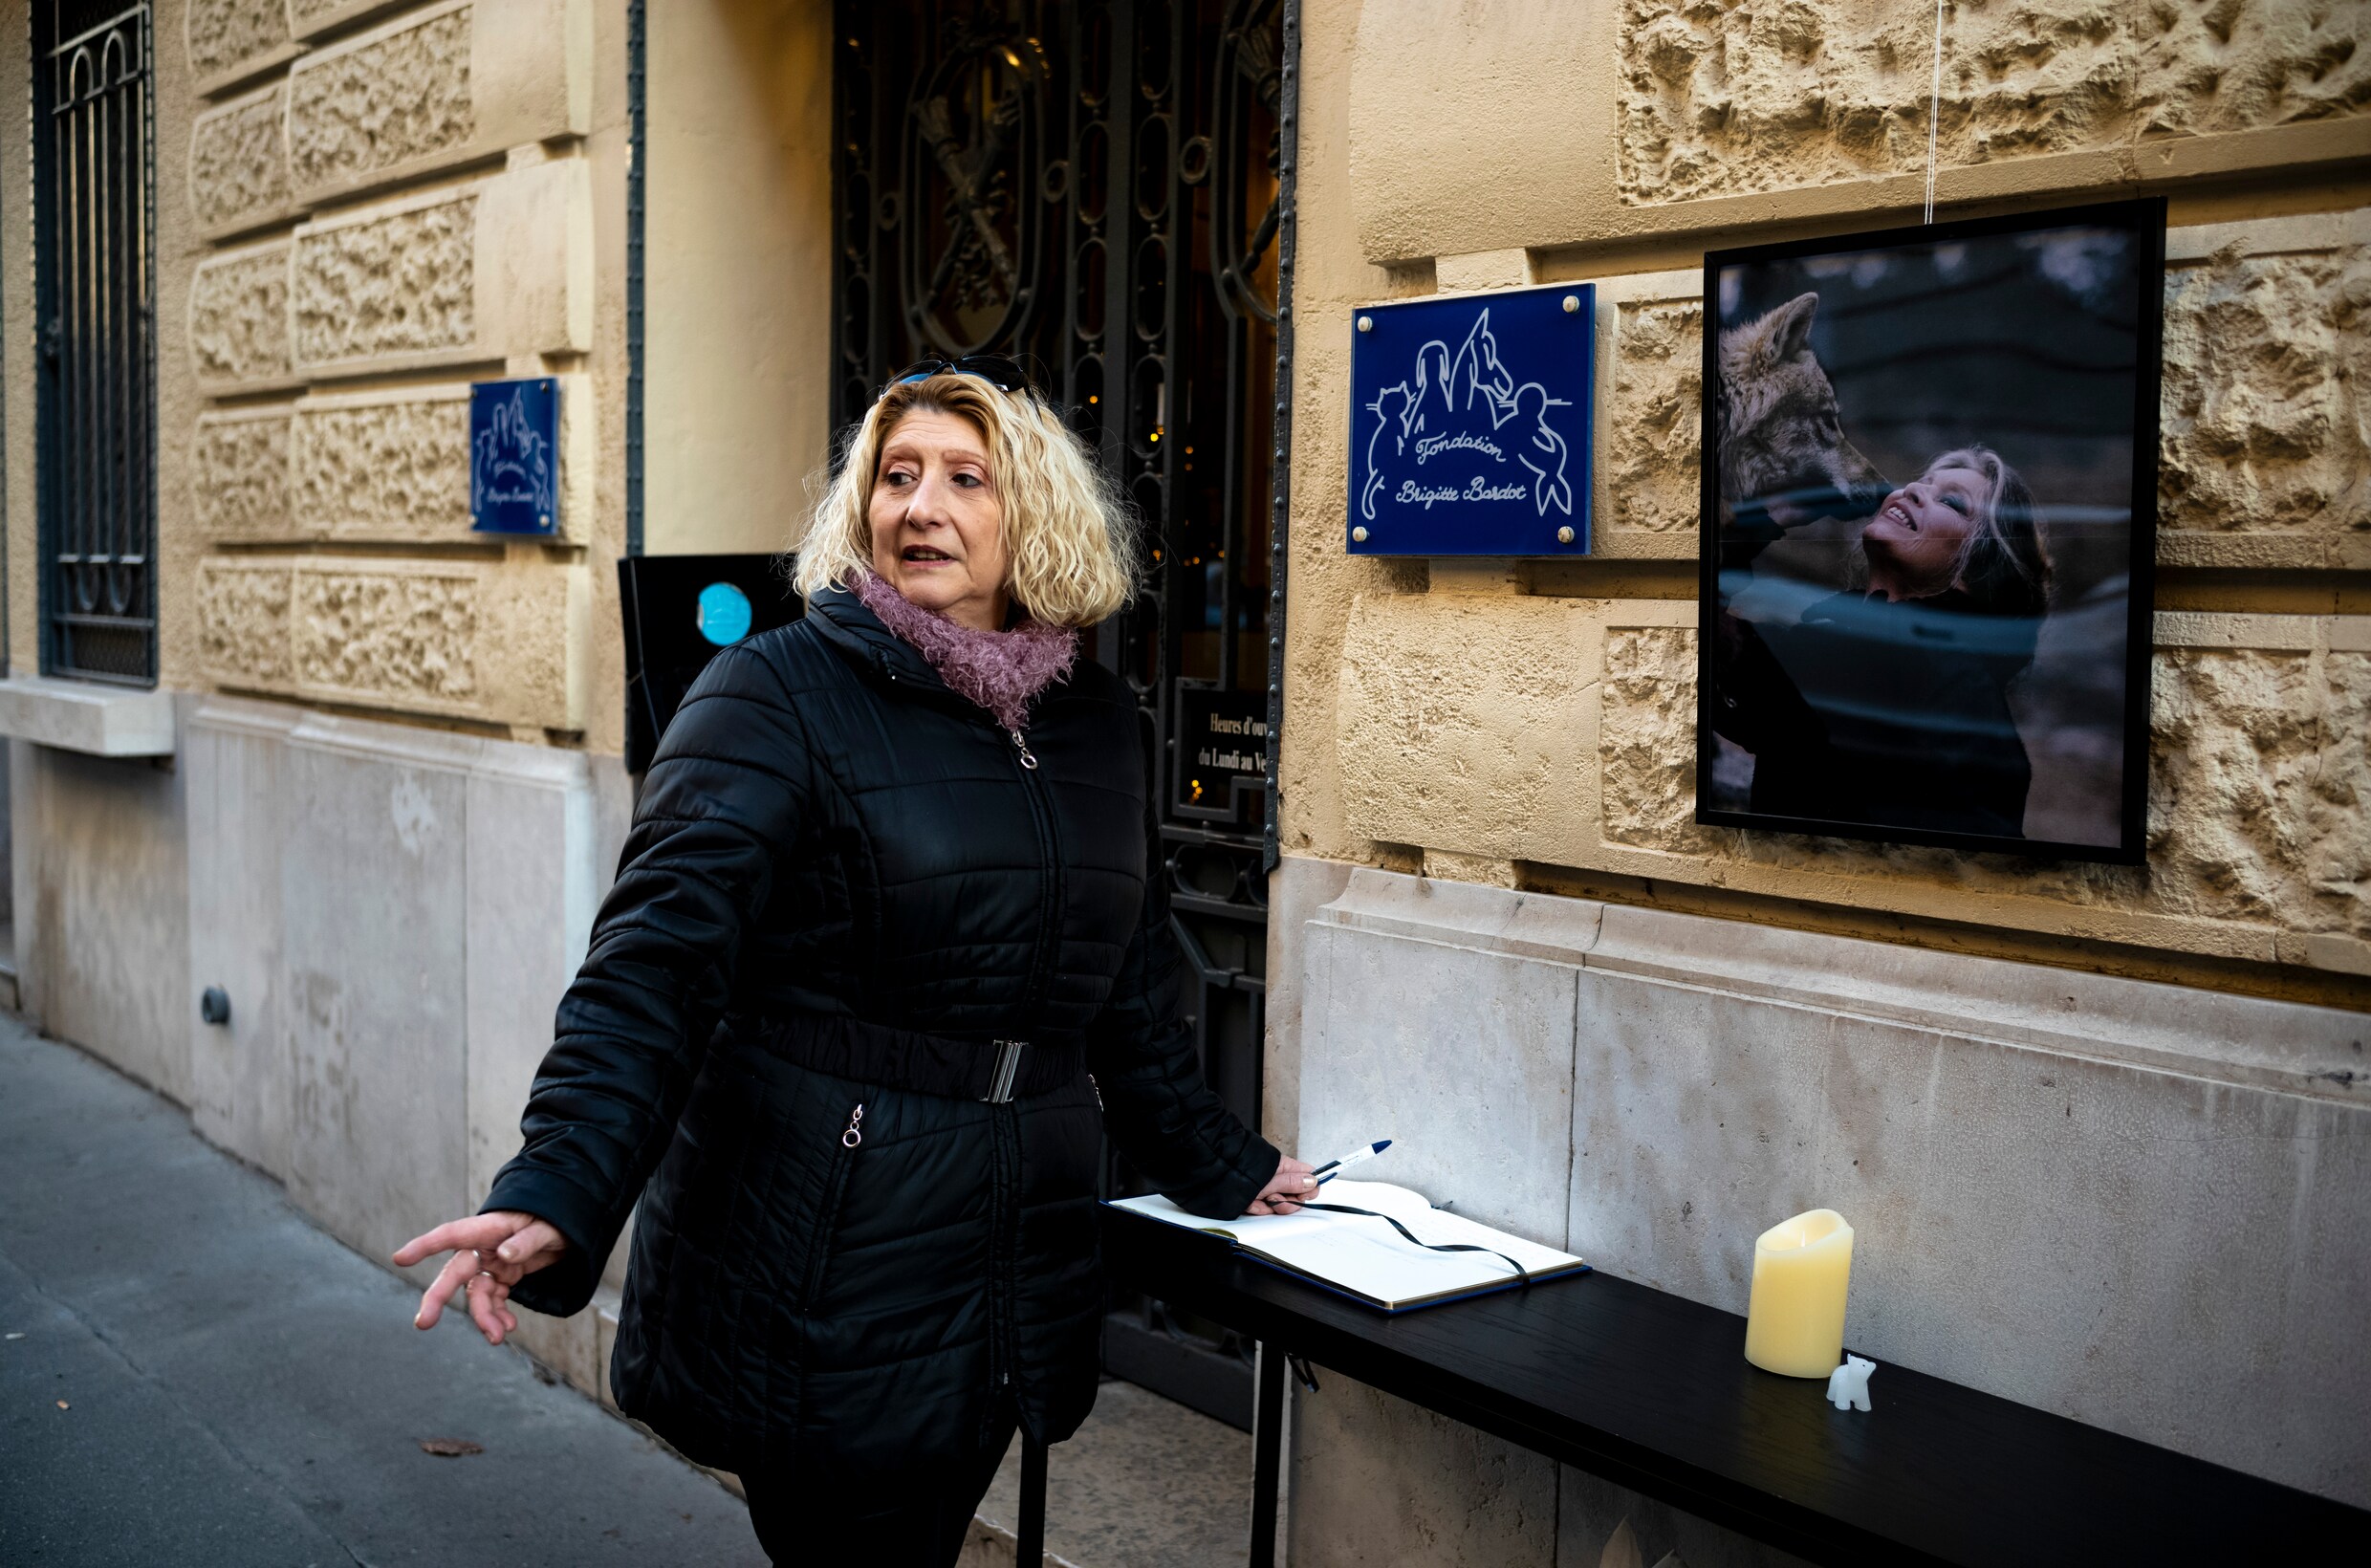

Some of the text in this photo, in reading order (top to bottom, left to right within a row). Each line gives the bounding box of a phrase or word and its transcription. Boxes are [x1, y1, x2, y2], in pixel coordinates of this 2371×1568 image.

[1415, 430, 1507, 466] Fondation
[1396, 476, 1527, 511] Brigitte Bardot
[1209, 712, 1243, 735] Heures
[1198, 747, 1210, 766] du
[1211, 747, 1240, 770] Lundi
[1240, 755, 1253, 772] au
